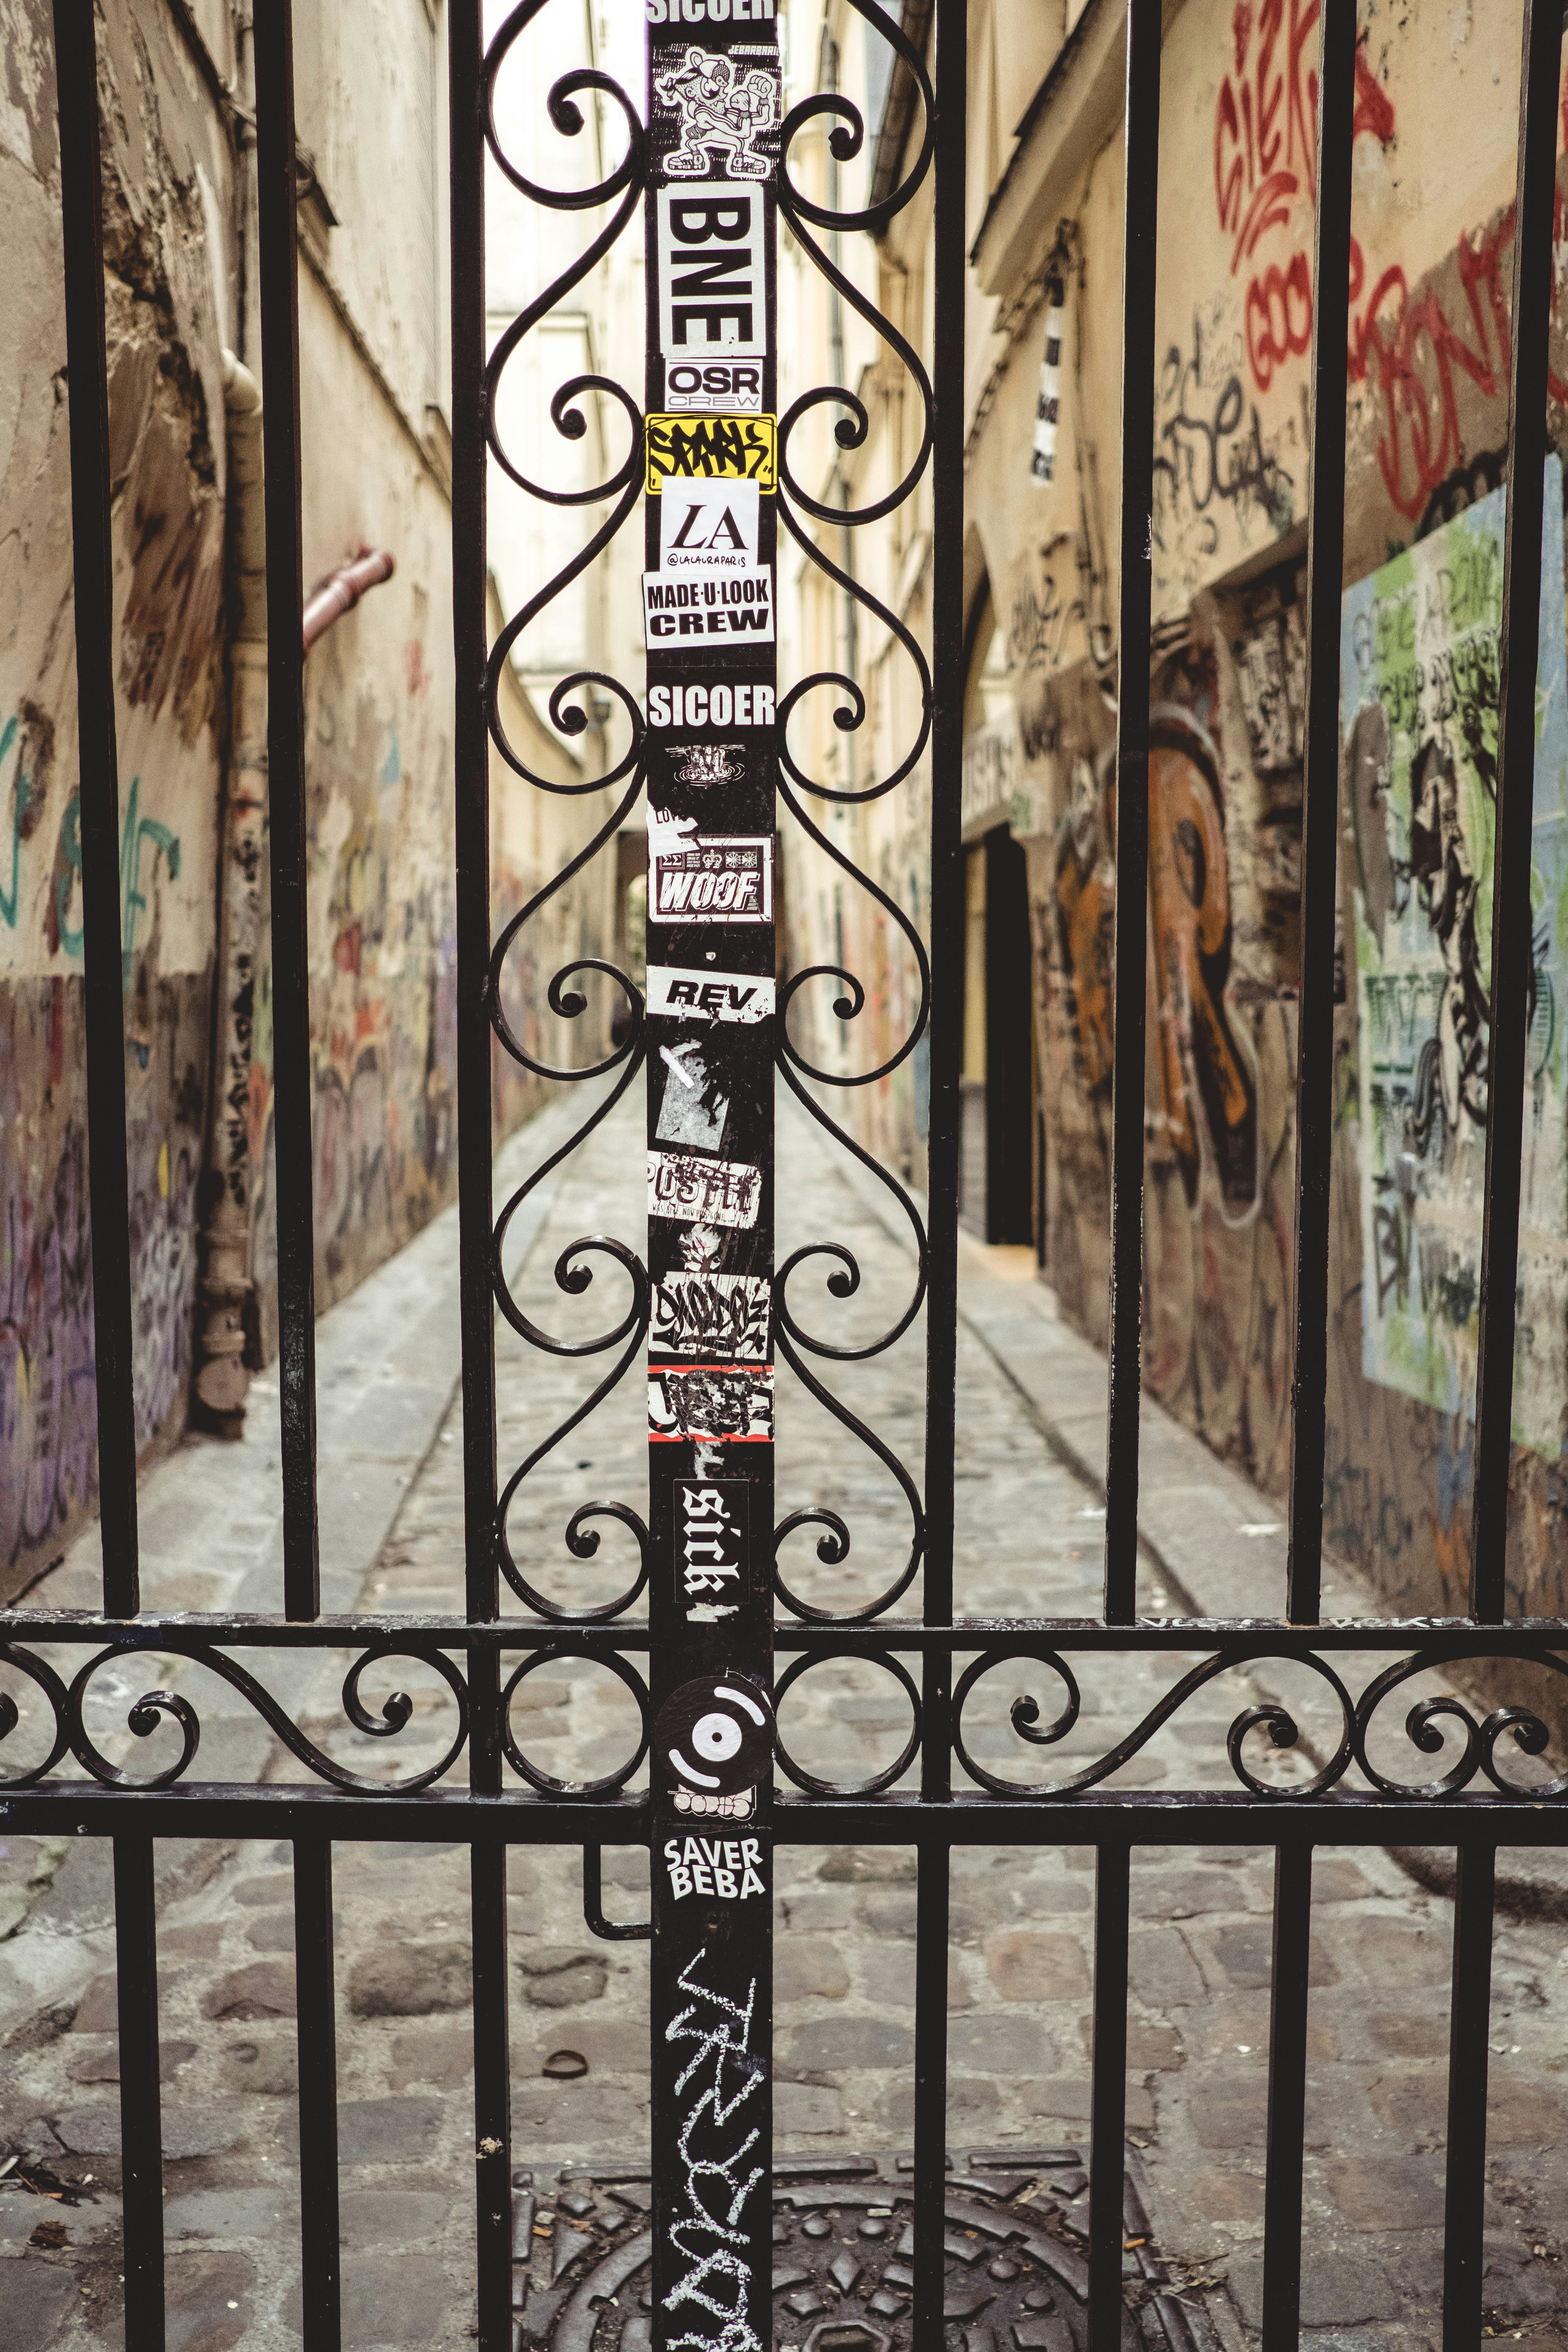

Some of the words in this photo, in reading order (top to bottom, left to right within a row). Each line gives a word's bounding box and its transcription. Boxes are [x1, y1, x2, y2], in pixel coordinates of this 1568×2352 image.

[669, 197, 753, 345] BNE
[668, 366, 760, 394] OSR
[668, 396, 759, 407] CREW
[667, 505, 749, 550] LA
[650, 608, 769, 637] CREW
[649, 685, 775, 726] SICOER
[659, 871, 760, 912] WOOF
[666, 980, 758, 1011] REV
[664, 1837, 763, 1871] SAVER
[670, 1864, 766, 1900] BEBA
